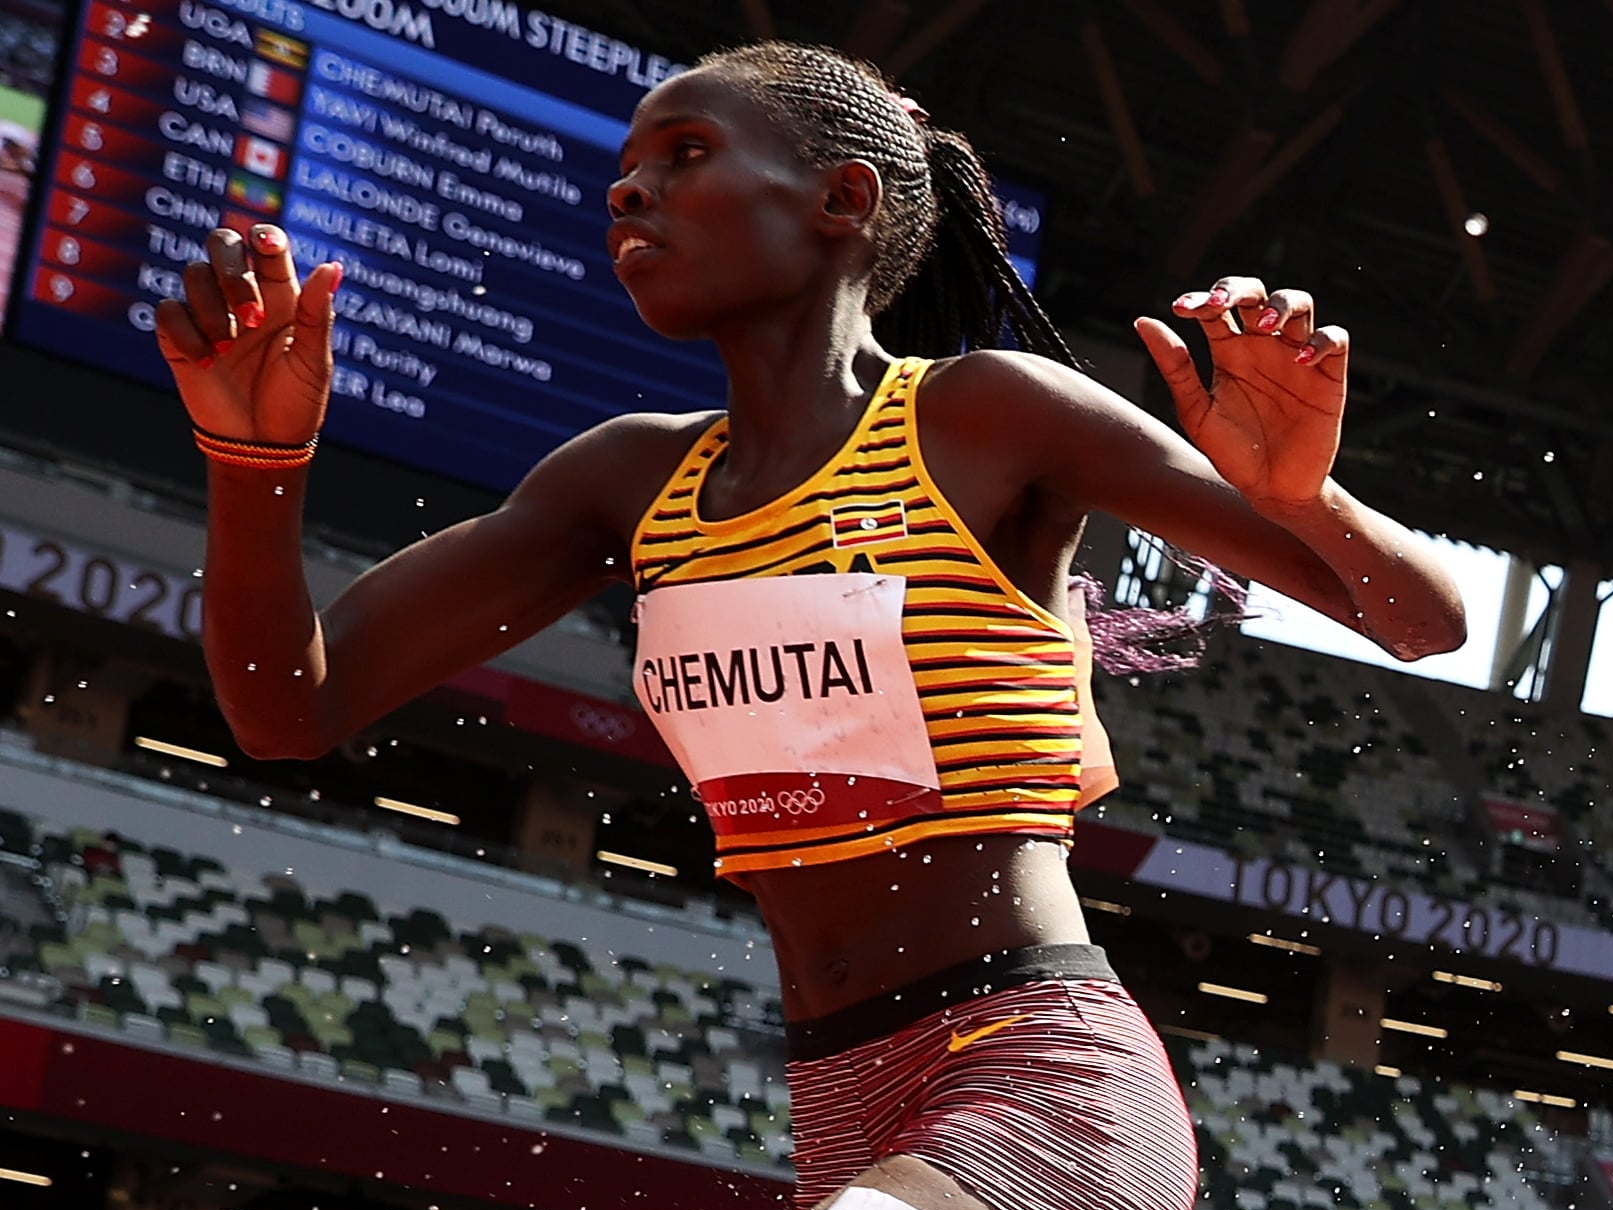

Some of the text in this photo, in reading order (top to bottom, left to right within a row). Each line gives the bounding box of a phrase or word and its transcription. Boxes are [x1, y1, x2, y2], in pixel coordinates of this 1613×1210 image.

[95, 47, 523, 222] 3 USA COBURN Emma
[182, 39, 248, 83] BRN
[310, 84, 377, 133] YAVI
[379, 111, 492, 174] Winfred
[493, 156, 582, 206] Mutile
[316, 52, 474, 129] CHEMUTAI
[475, 110, 563, 162] Peruth
[71, 160, 96, 189] 6
[145, 186, 220, 230] CHN
[80, 122, 485, 283] 5 ETH MULETA Lomi
[87, 89, 586, 281] 4 CAN LALONDE Genevieve
[51, 274, 75, 302] 9
[371, 379, 426, 418] Lea
[57, 236, 82, 265] 8
[138, 263, 188, 303] KE
[353, 334, 438, 388] Purity
[67, 197, 90, 225] 7
[452, 330, 552, 382] Marwa
[643, 638, 873, 715] CHEMUTAI
[738, 797, 776, 815] 2020
[1228, 853, 1559, 968] TOKYO 2020
